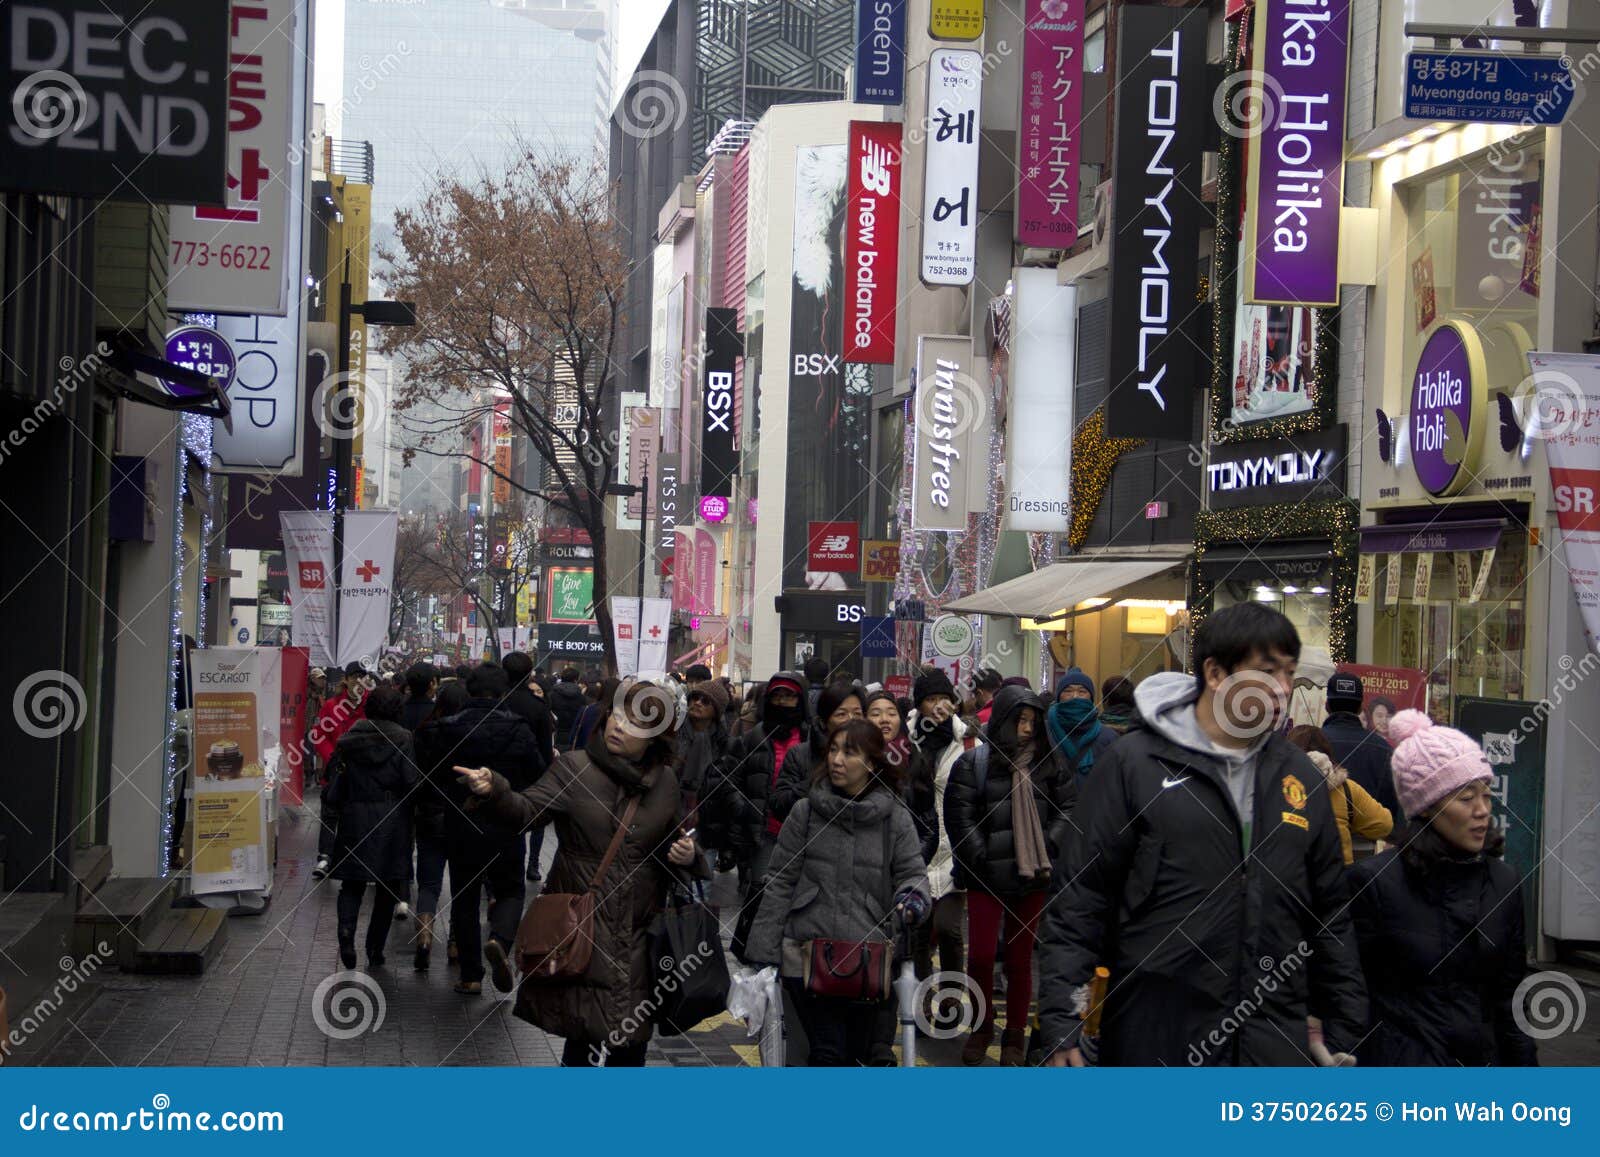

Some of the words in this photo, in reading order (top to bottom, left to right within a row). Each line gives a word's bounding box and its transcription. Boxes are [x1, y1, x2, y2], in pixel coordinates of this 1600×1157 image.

[11, 5, 209, 84] DEC.
[872, 1, 892, 76] saem
[1412, 58, 1499, 83] 명동8가길
[1411, 84, 1500, 103] Myeongdong
[1504, 88, 1554, 104] 8ga-gil
[1027, 167, 1041, 179] 3F
[1274, 93, 1330, 253] Holika
[858, 197, 877, 247] new
[1137, 31, 1179, 412] TONYMOLY
[171, 241, 271, 271] 773-6622
[928, 265, 968, 276] 752-0368
[855, 252, 879, 349] balance
[795, 354, 840, 376] BSX
[708, 371, 732, 432] BSX
[1417, 373, 1462, 410] Holika
[931, 358, 960, 508] innisfree
[1416, 413, 1448, 452] Holi
[1207, 449, 1321, 492] TONYMOLY
[1010, 496, 1069, 516] Dressing
[1555, 484, 1594, 514] SR
[661, 501, 676, 548] SKIN
[813, 552, 828, 560] new
[829, 552, 855, 560] balance
[302, 569, 321, 581] SR
[561, 574, 582, 593] Give
[558, 591, 580, 614] Joy
[837, 604, 866, 622] BS
[548, 640, 564, 650] THE
[566, 641, 588, 651] BODY
[1386, 678, 1409, 690] 2013
